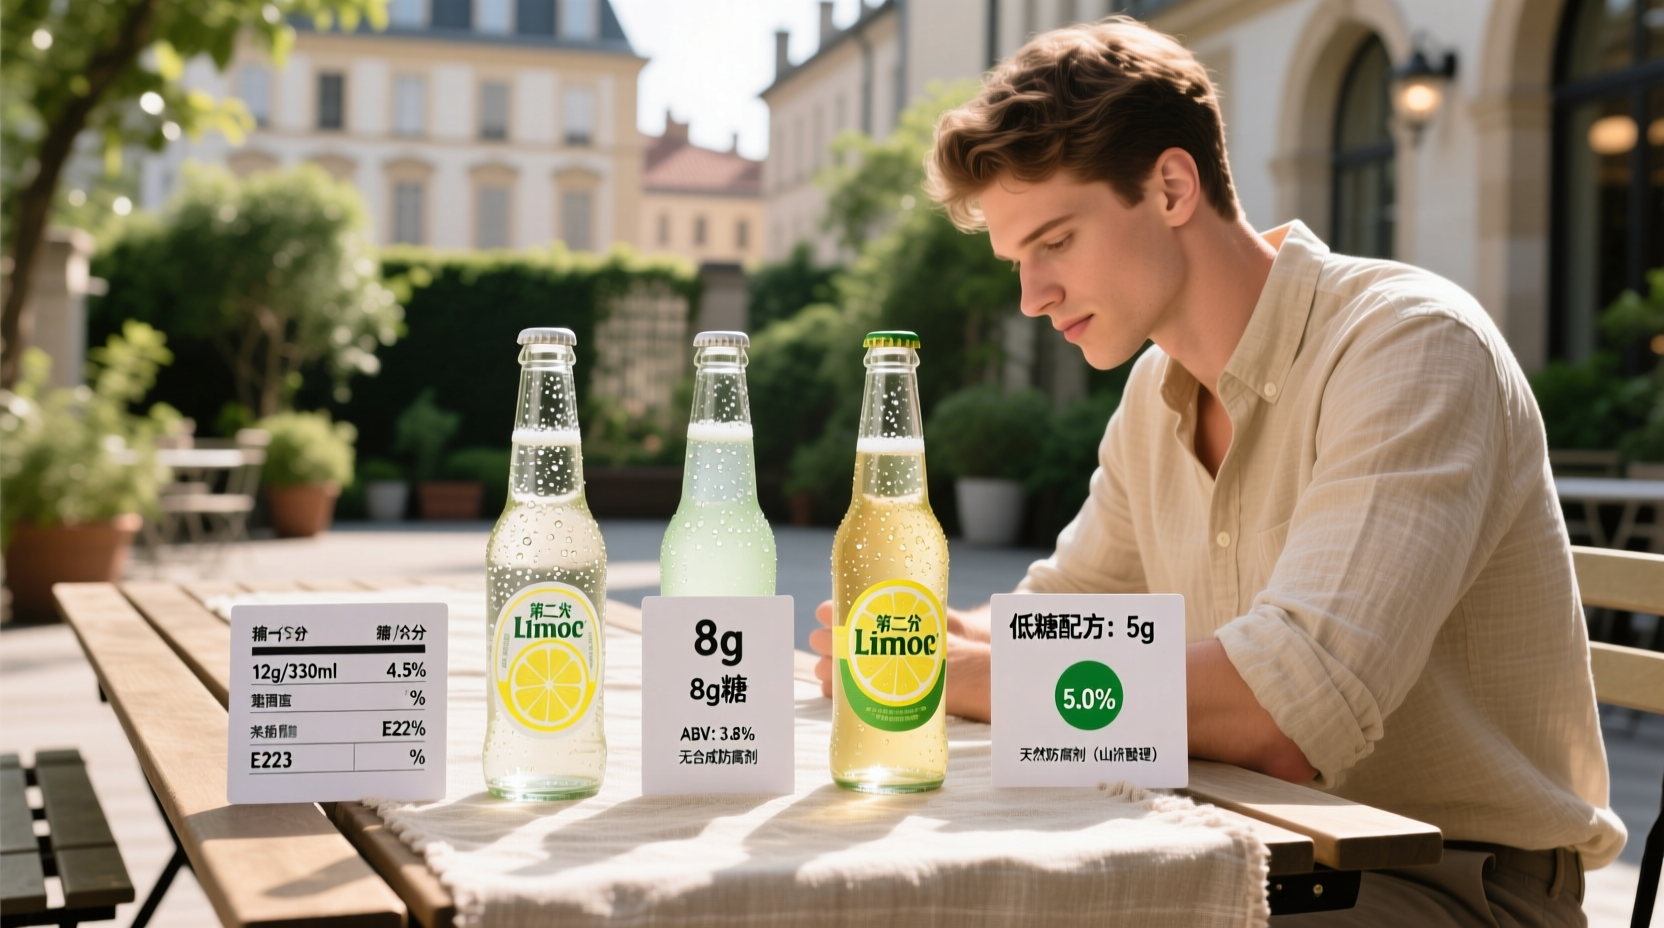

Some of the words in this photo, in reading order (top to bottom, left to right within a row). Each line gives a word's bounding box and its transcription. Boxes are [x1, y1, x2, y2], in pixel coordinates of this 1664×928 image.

[1126, 615, 1155, 644] 5g
[694, 619, 743, 667] 8g
[252, 663, 337, 683] 12g/330ml
[386, 662, 427, 678] 4.5%
[690, 674, 748, 707] 8g糖
[1063, 688, 1116, 710] 5.0%
[382, 720, 426, 737] E22%
[680, 726, 716, 741] ABV:
[719, 727, 755, 741] 3.8%
[250, 751, 292, 769] E223
